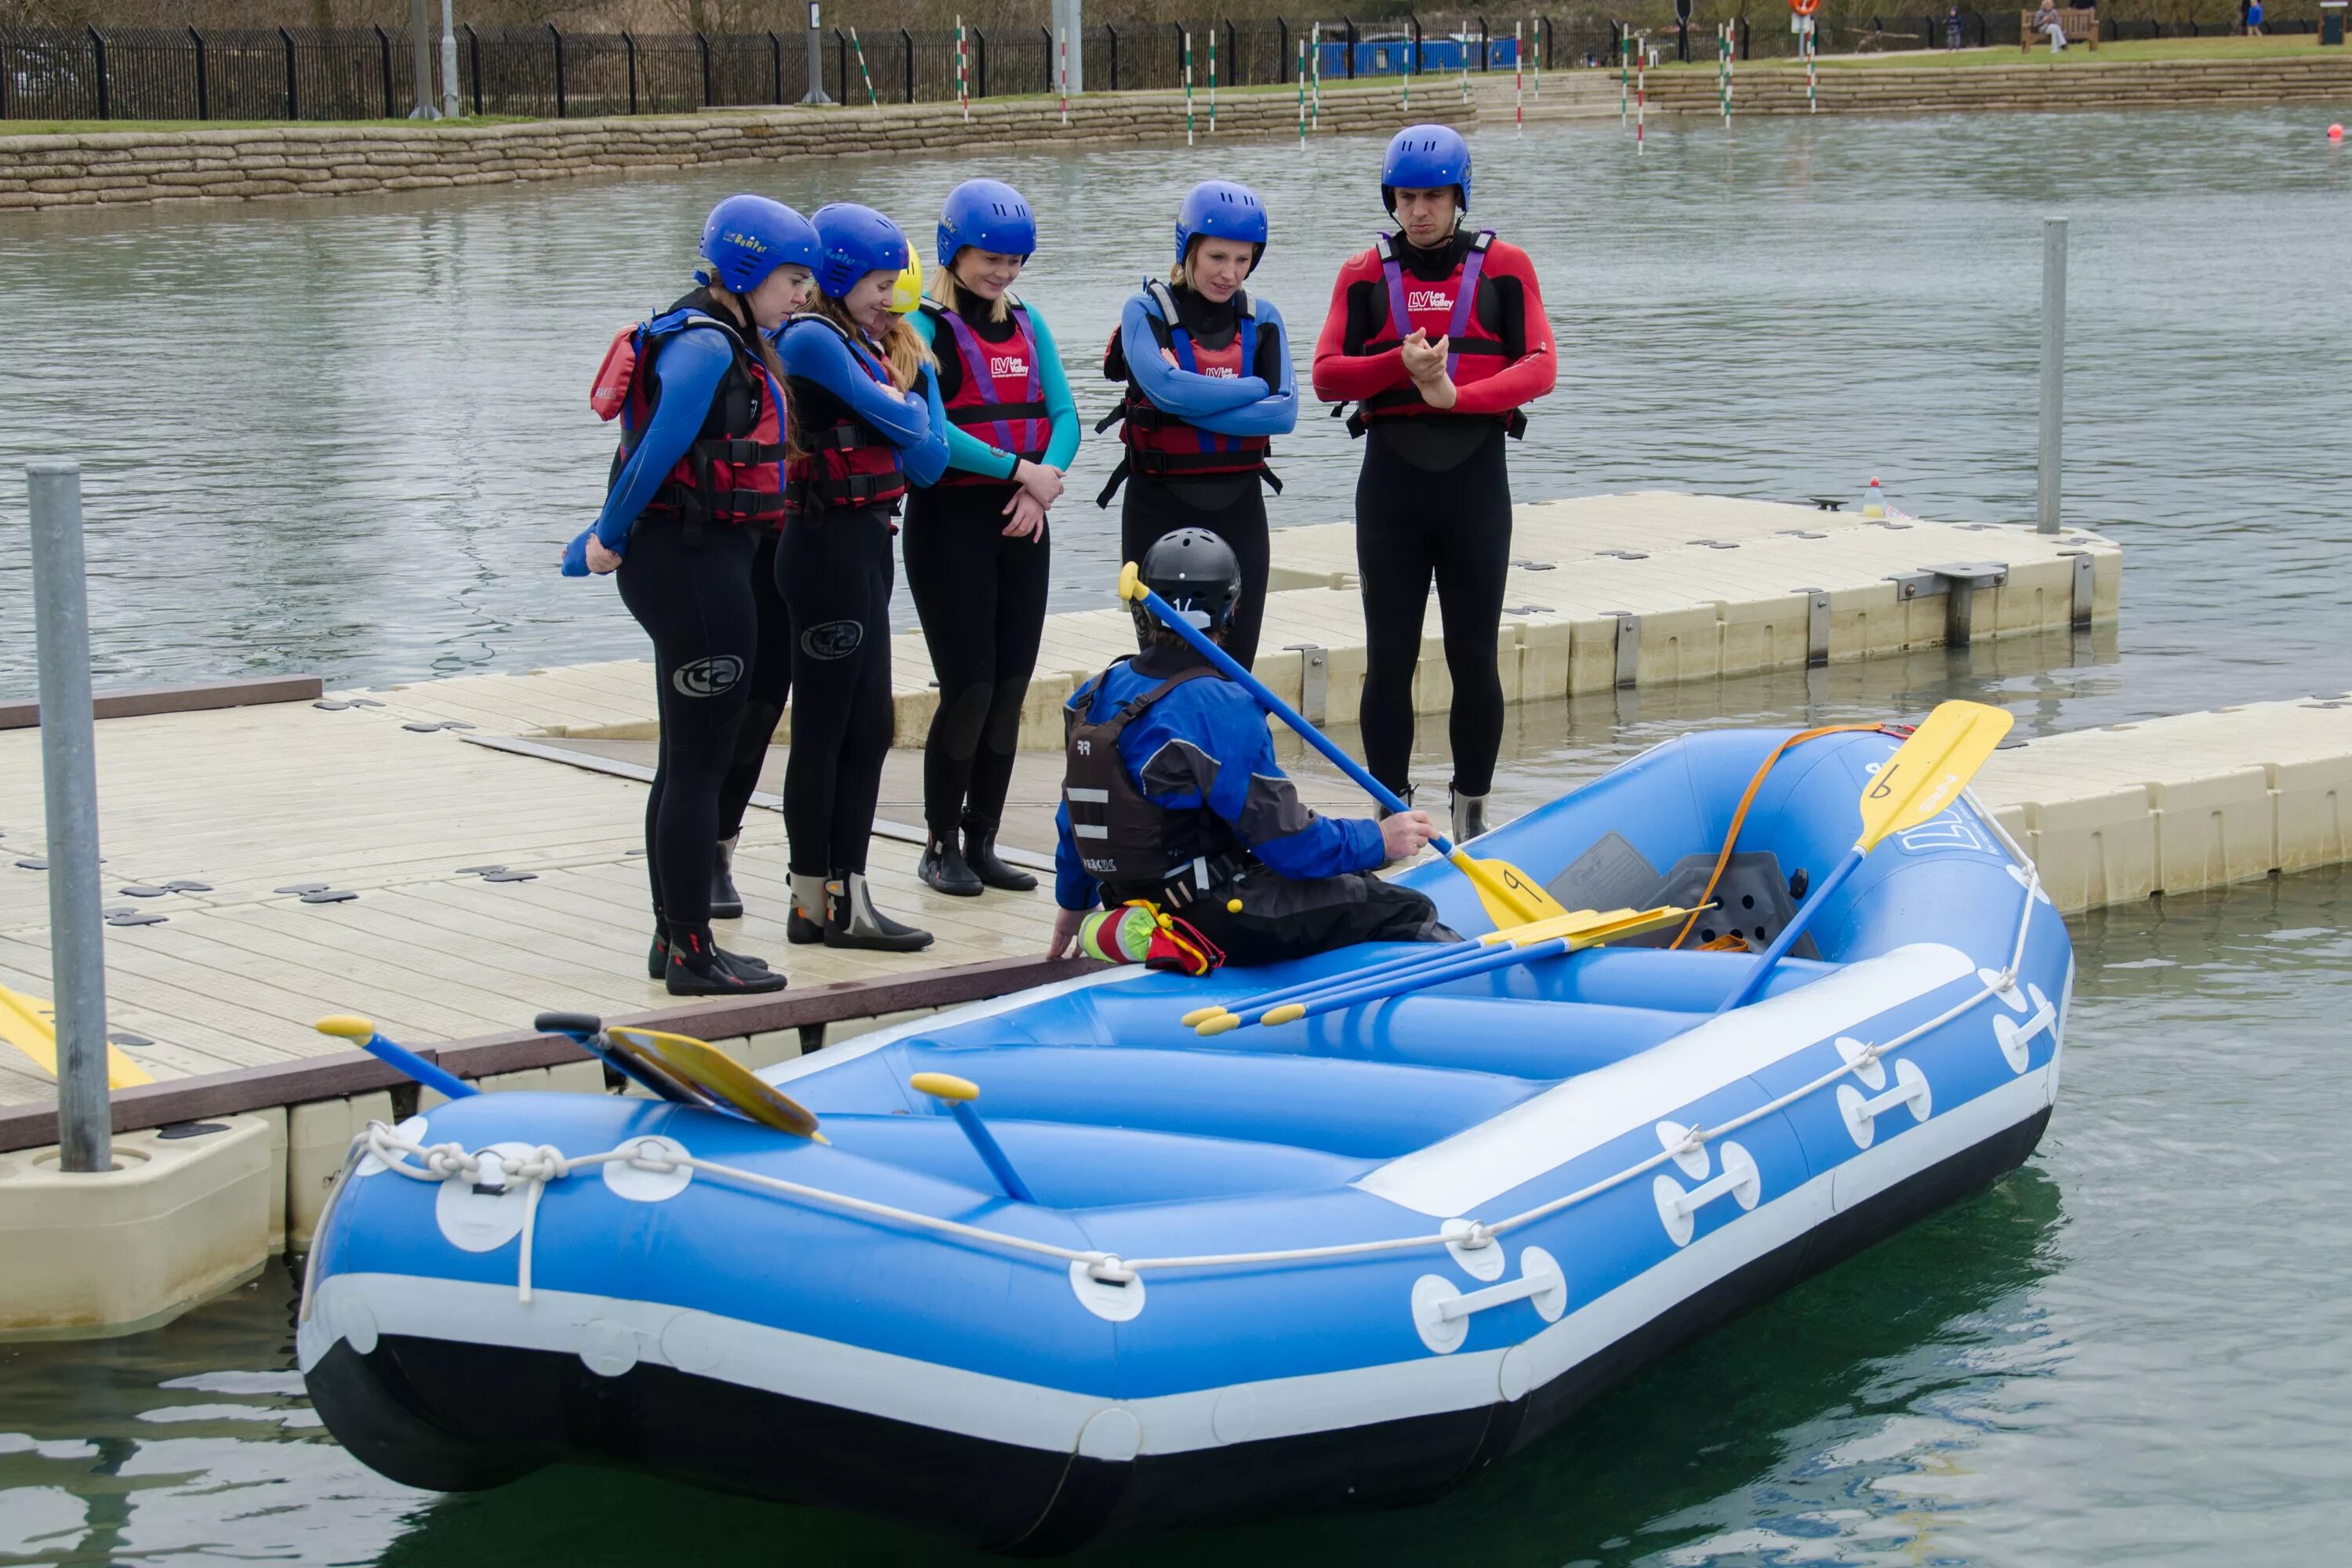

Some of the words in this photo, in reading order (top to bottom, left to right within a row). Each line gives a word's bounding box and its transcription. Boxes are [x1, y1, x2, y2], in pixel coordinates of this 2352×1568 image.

[1408, 291, 1430, 308] LV
[1430, 299, 1454, 309] Valley
[991, 357, 1010, 374] LV
[1010, 365, 1029, 374] Valley
